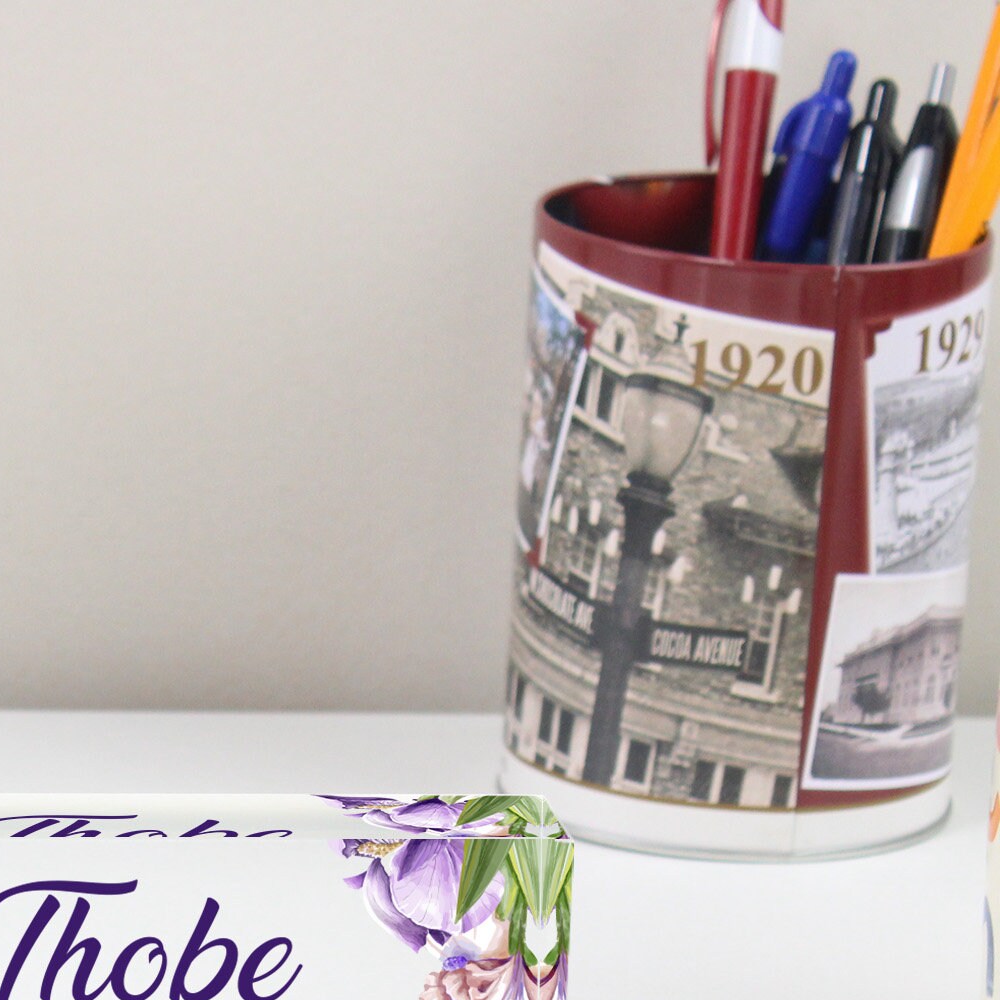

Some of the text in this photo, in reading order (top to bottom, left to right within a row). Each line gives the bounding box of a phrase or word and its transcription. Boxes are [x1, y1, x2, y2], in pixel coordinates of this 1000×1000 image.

[689, 339, 825, 397] 1920
[915, 307, 985, 375] 1929
[651, 629, 746, 667] COCOA AVENUE
